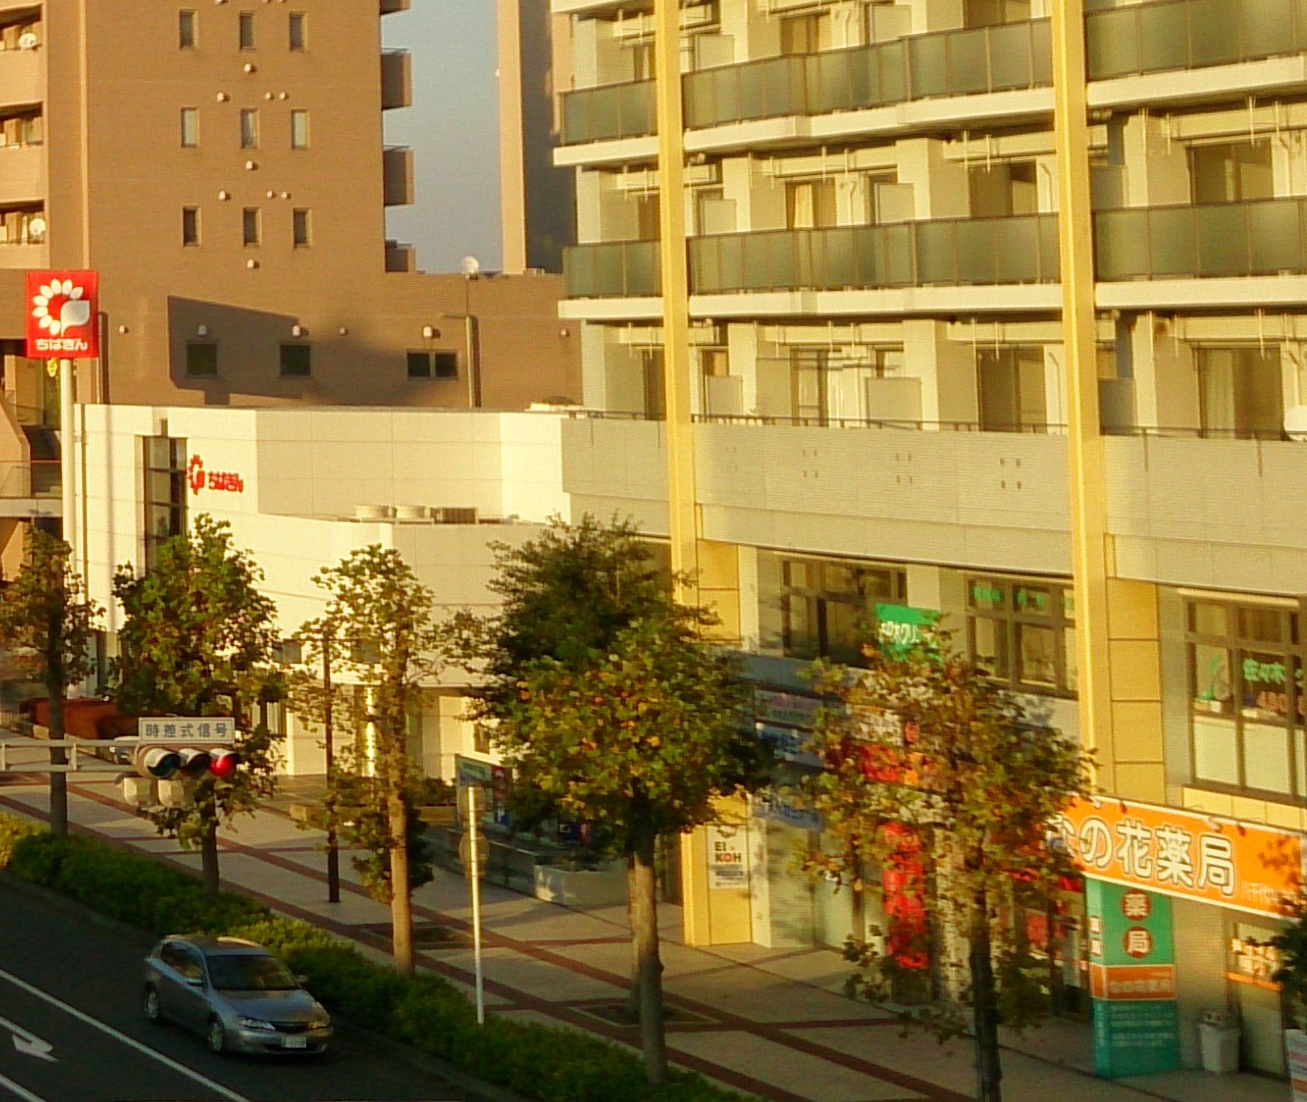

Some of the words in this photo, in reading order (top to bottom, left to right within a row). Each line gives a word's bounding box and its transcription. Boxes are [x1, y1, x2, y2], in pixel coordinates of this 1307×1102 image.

[36, 338, 88, 351] ちばぎん
[145, 722, 228, 738] 時差式信号
